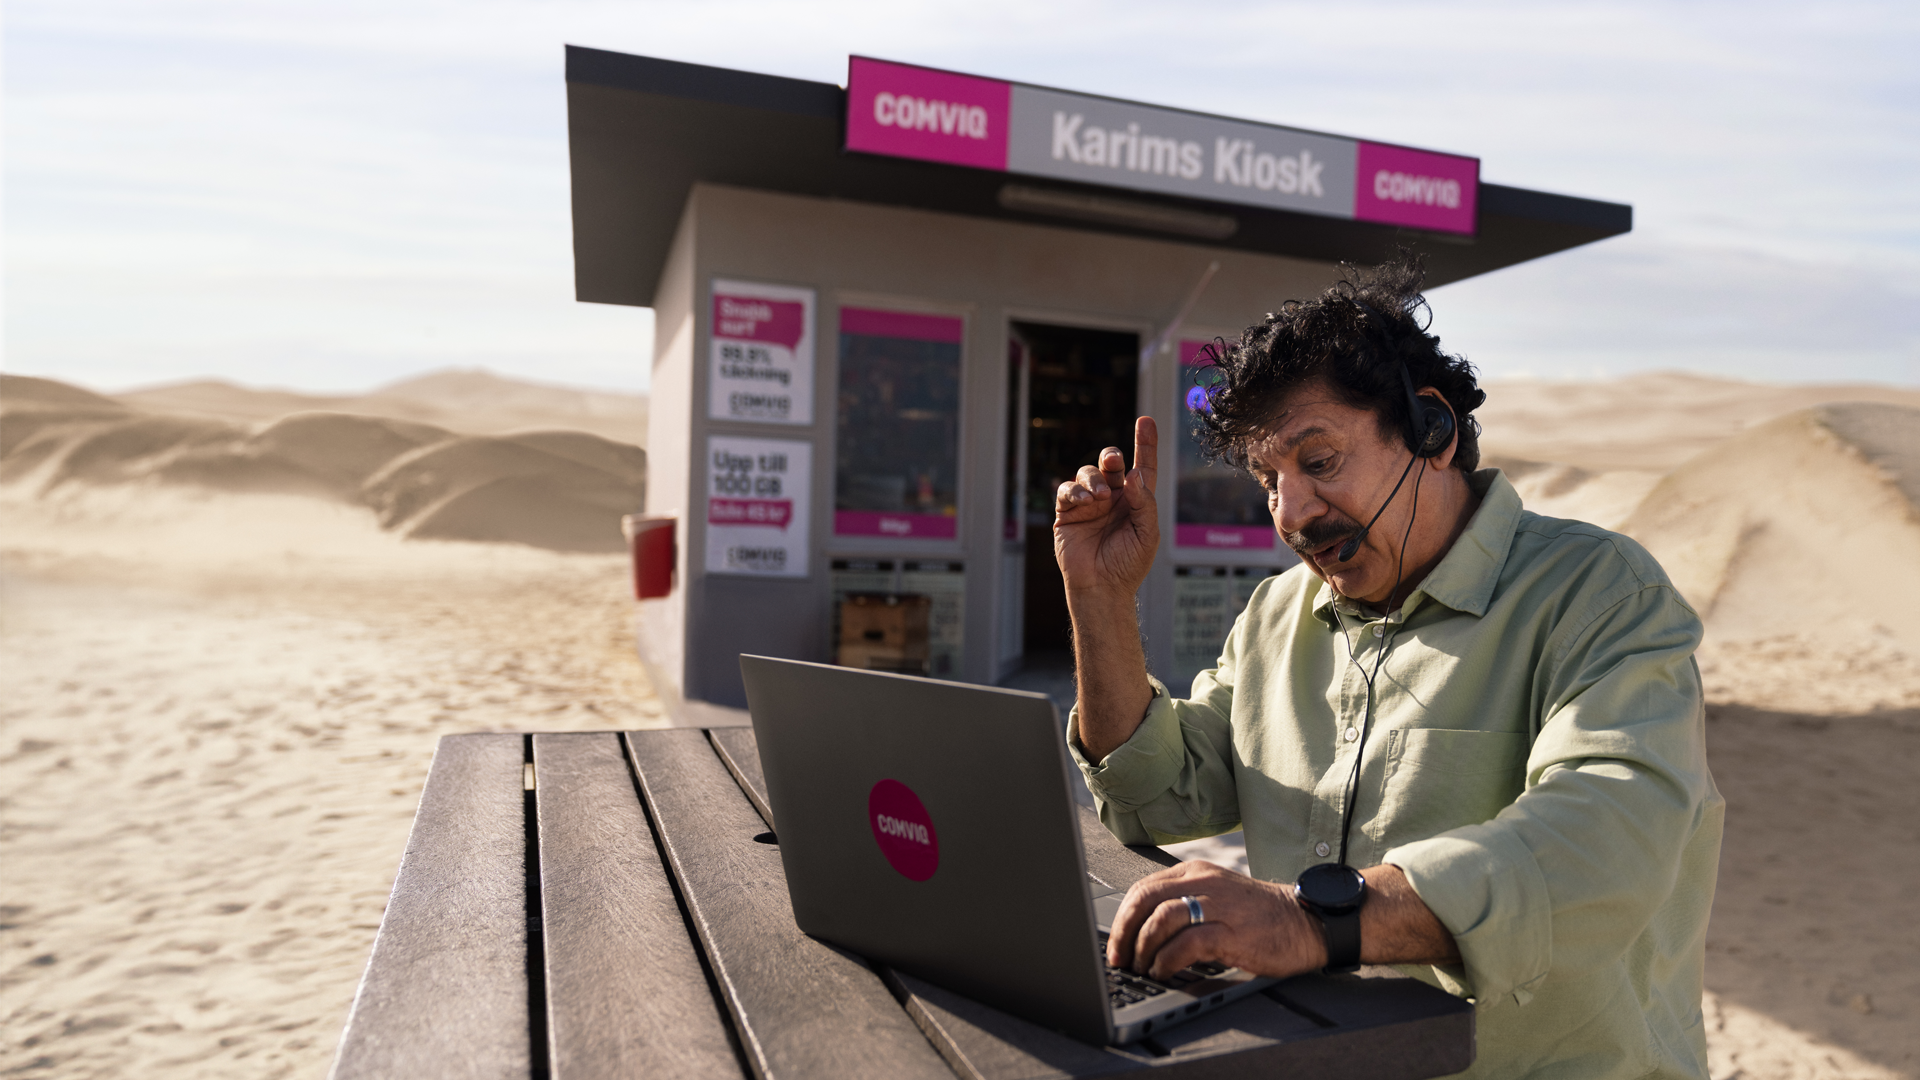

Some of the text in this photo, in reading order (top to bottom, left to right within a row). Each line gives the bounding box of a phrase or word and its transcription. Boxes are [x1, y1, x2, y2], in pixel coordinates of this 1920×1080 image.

[873, 91, 988, 140] COMVIQ
[1052, 110, 1325, 197] Karims Kiosk
[1374, 169, 1462, 209] COMVIQ
[714, 451, 787, 473] Upp till
[715, 476, 782, 495] 100 GB
[877, 813, 931, 845] COMVIQ
